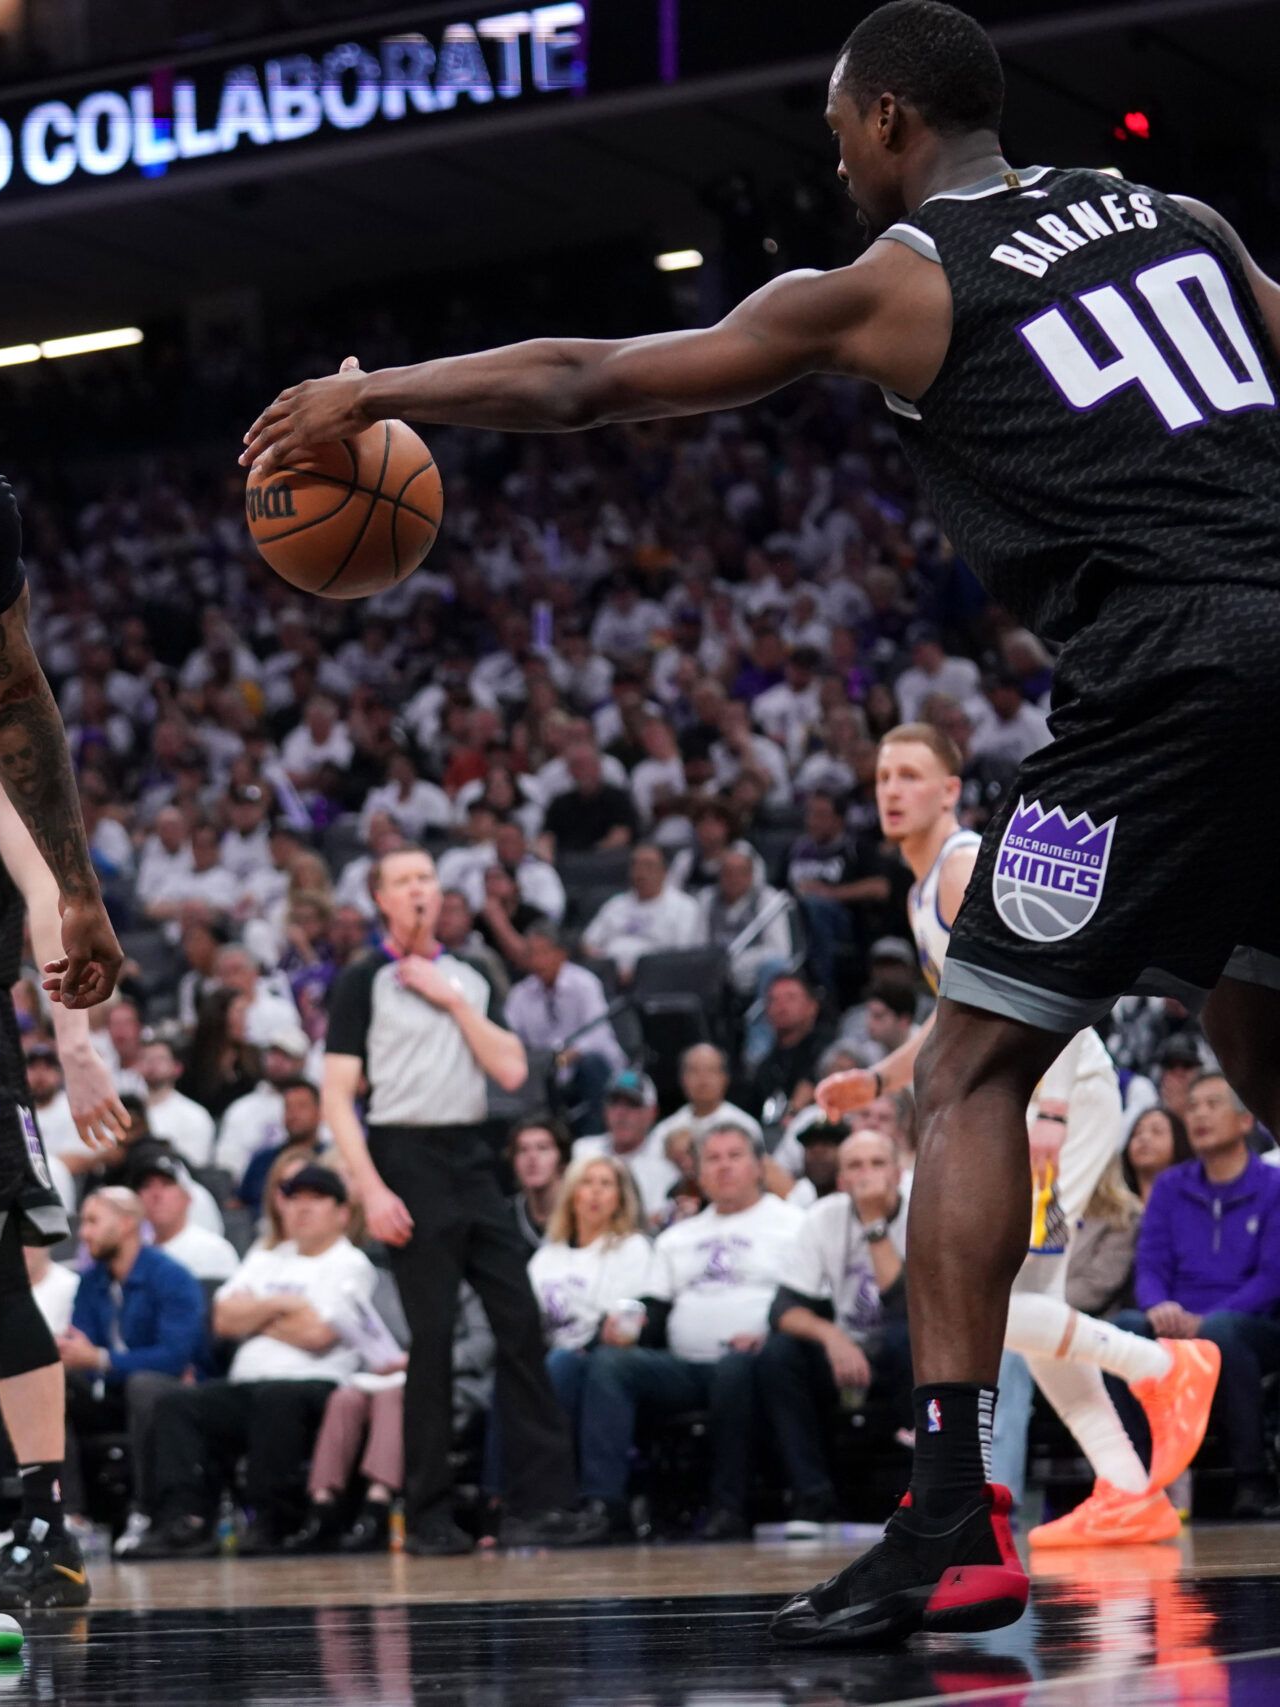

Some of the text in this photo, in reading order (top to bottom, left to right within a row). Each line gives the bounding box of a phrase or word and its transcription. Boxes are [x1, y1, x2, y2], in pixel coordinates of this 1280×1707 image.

[23, 2, 586, 185] COLLABORATE
[990, 192, 1158, 278] BARNES
[1016, 249, 1277, 433] 40
[998, 851, 1100, 898] KINGS
[1007, 834, 1100, 866] SACRAMENTO
